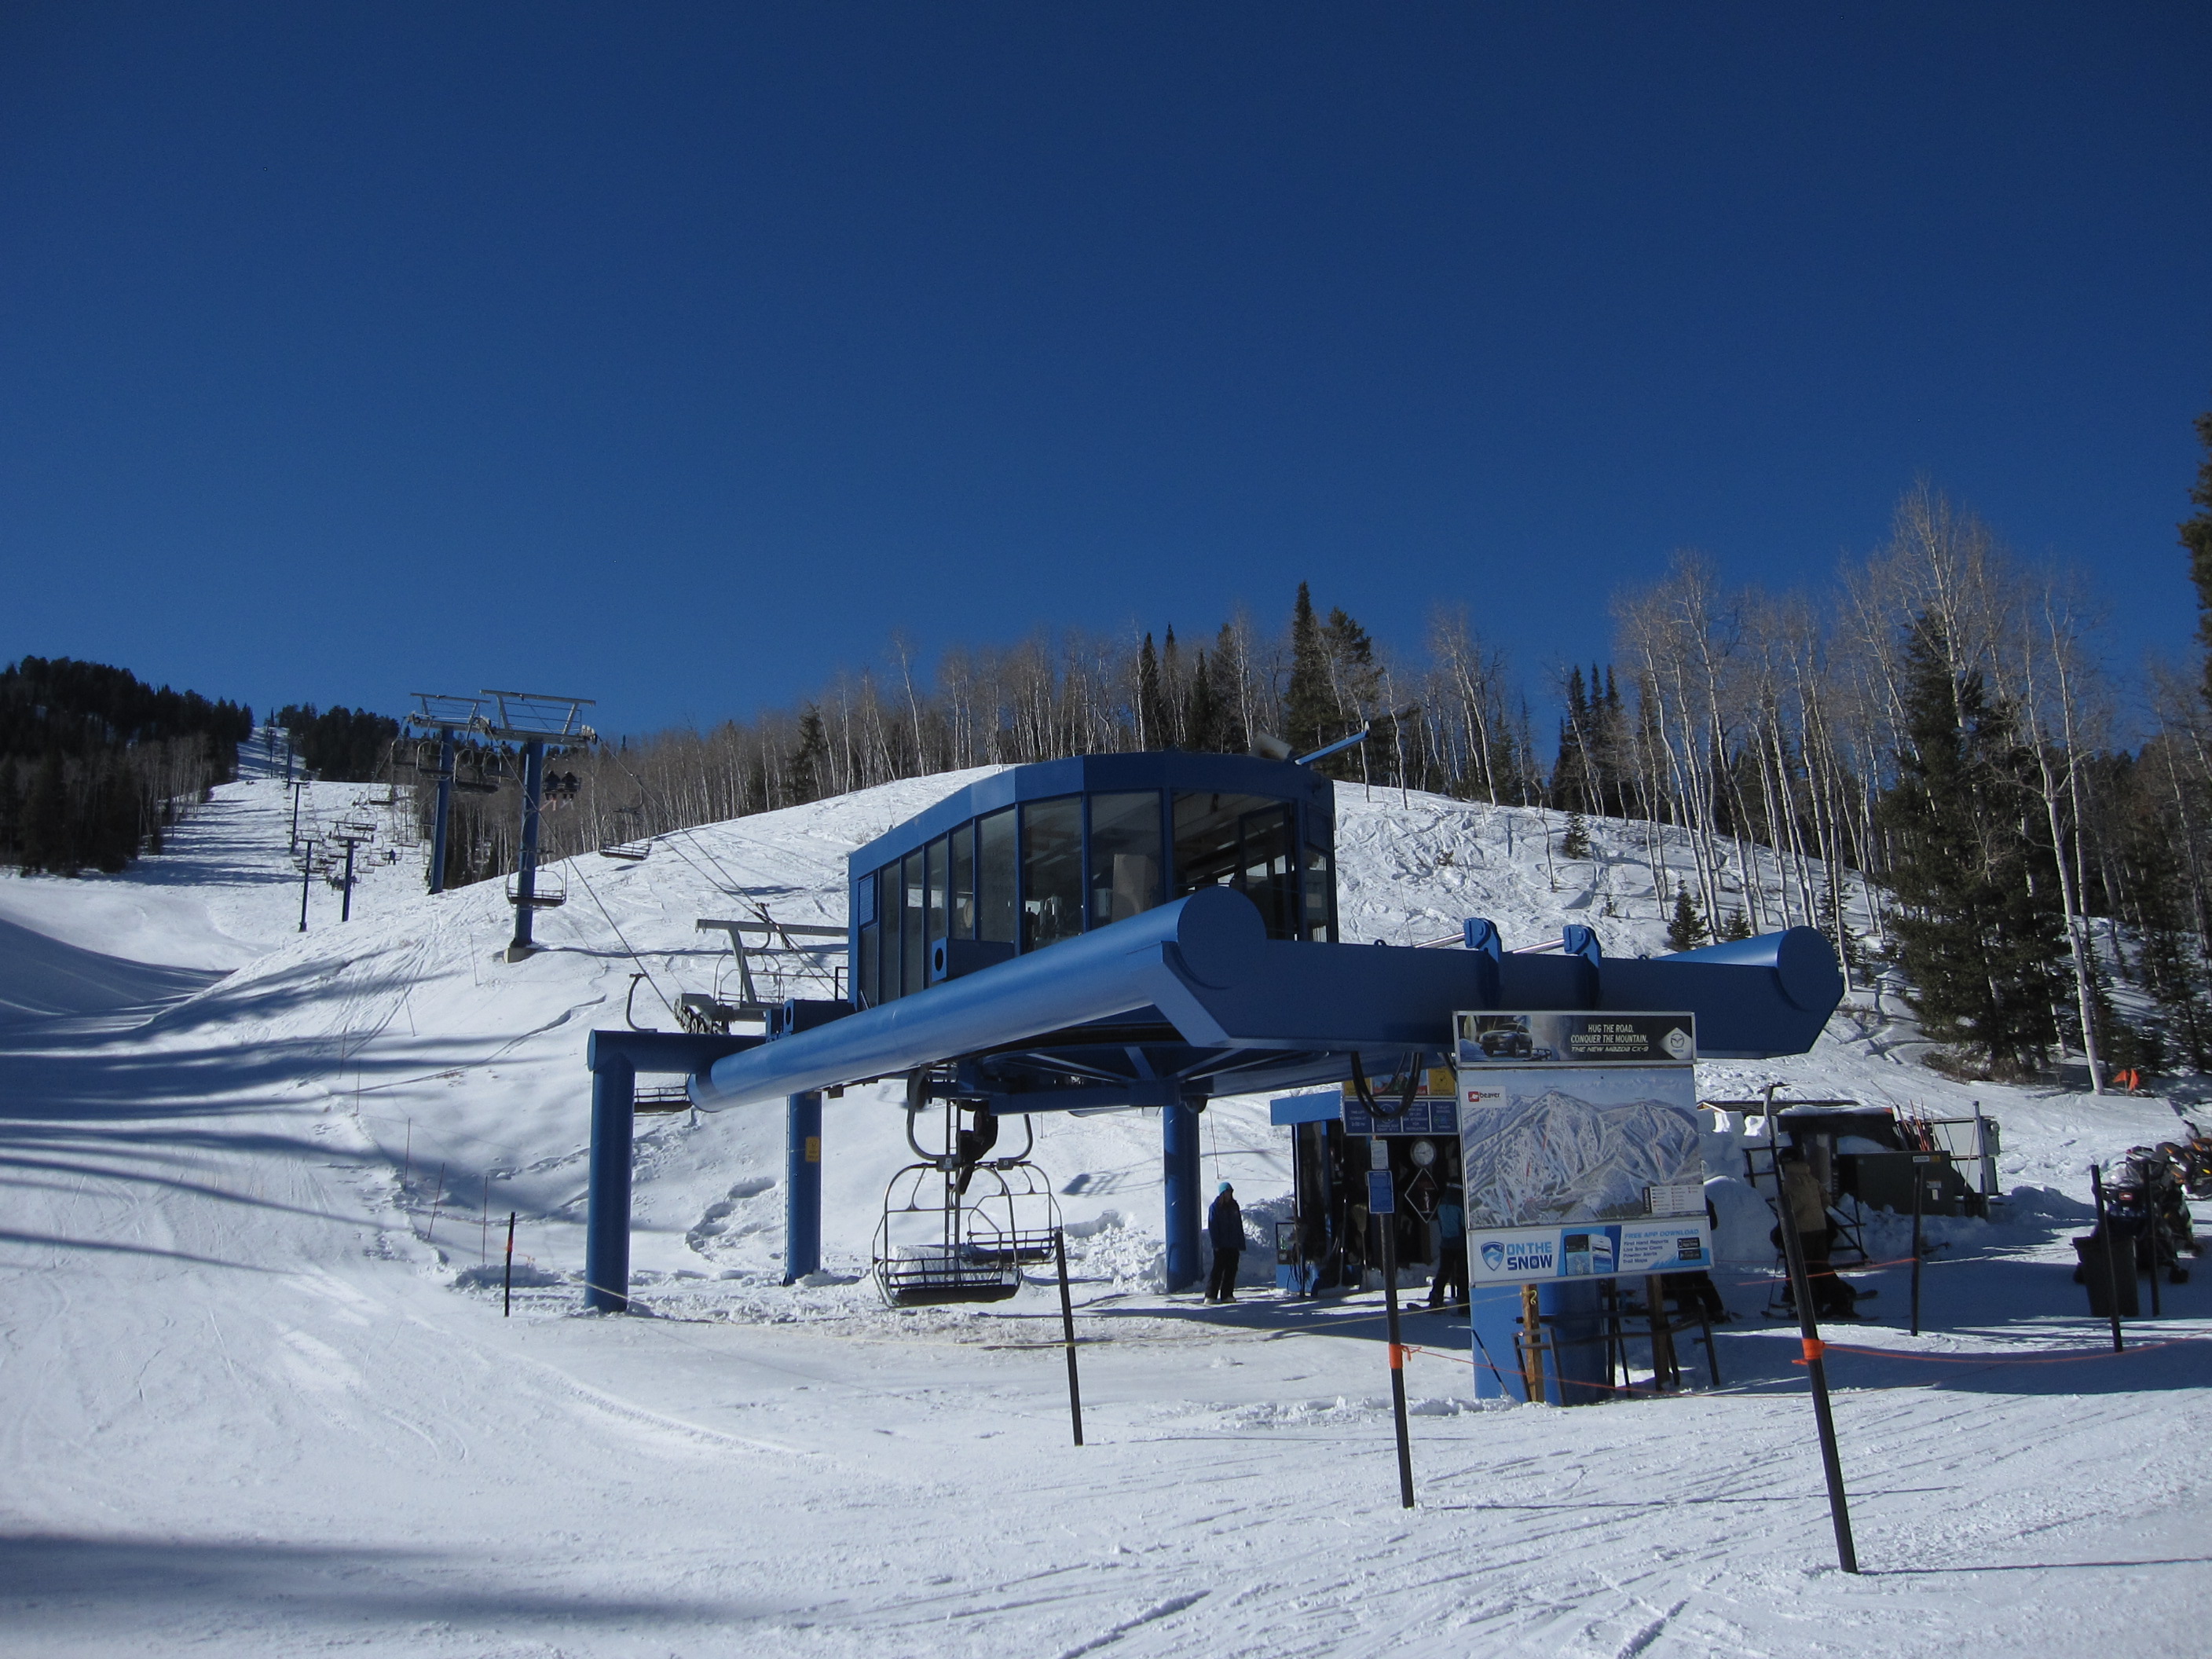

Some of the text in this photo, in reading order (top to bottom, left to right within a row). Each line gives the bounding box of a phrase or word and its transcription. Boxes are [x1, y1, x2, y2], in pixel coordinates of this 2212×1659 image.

[1588, 1024, 1634, 1033] HUG THE ROAD.
[1570, 1035, 1648, 1043] CONQUER THE MOUNTAIN.
[1507, 1254, 1552, 1270] SNOW
